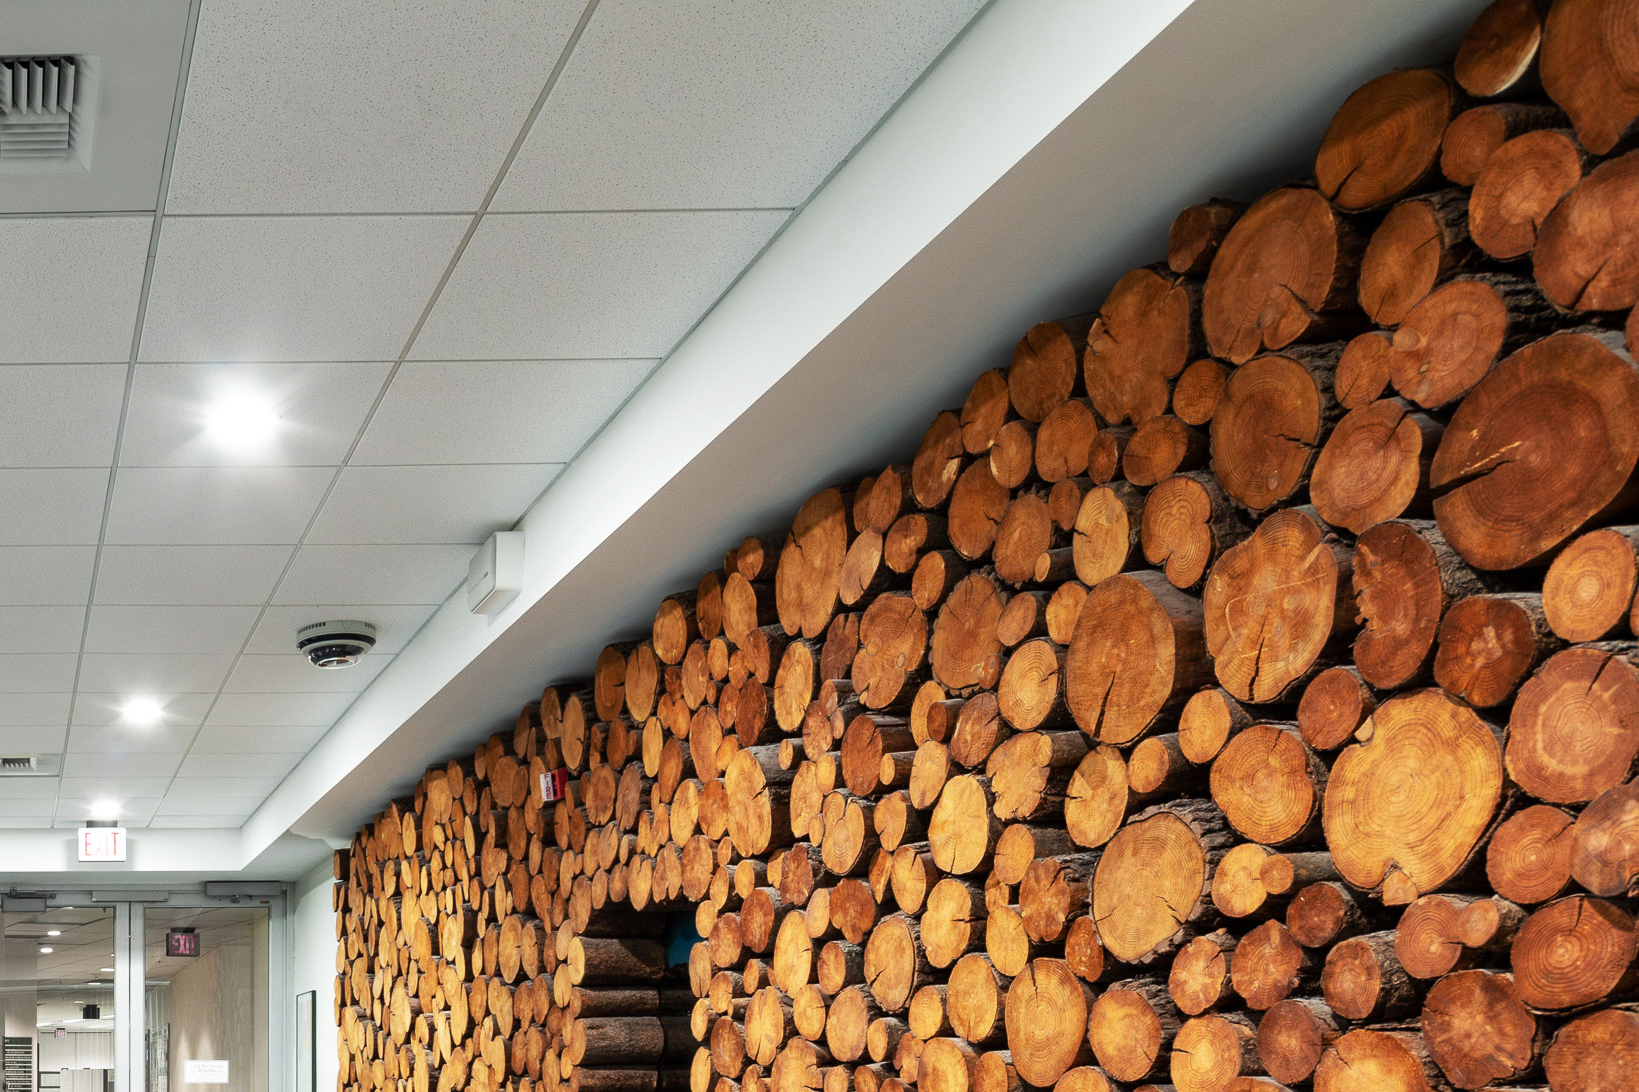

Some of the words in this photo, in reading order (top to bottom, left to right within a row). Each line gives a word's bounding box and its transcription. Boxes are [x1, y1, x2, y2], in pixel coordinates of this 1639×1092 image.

[544, 774, 552, 800] FIRE
[85, 833, 119, 856] EXIT
[172, 935, 195, 954] EXIT
